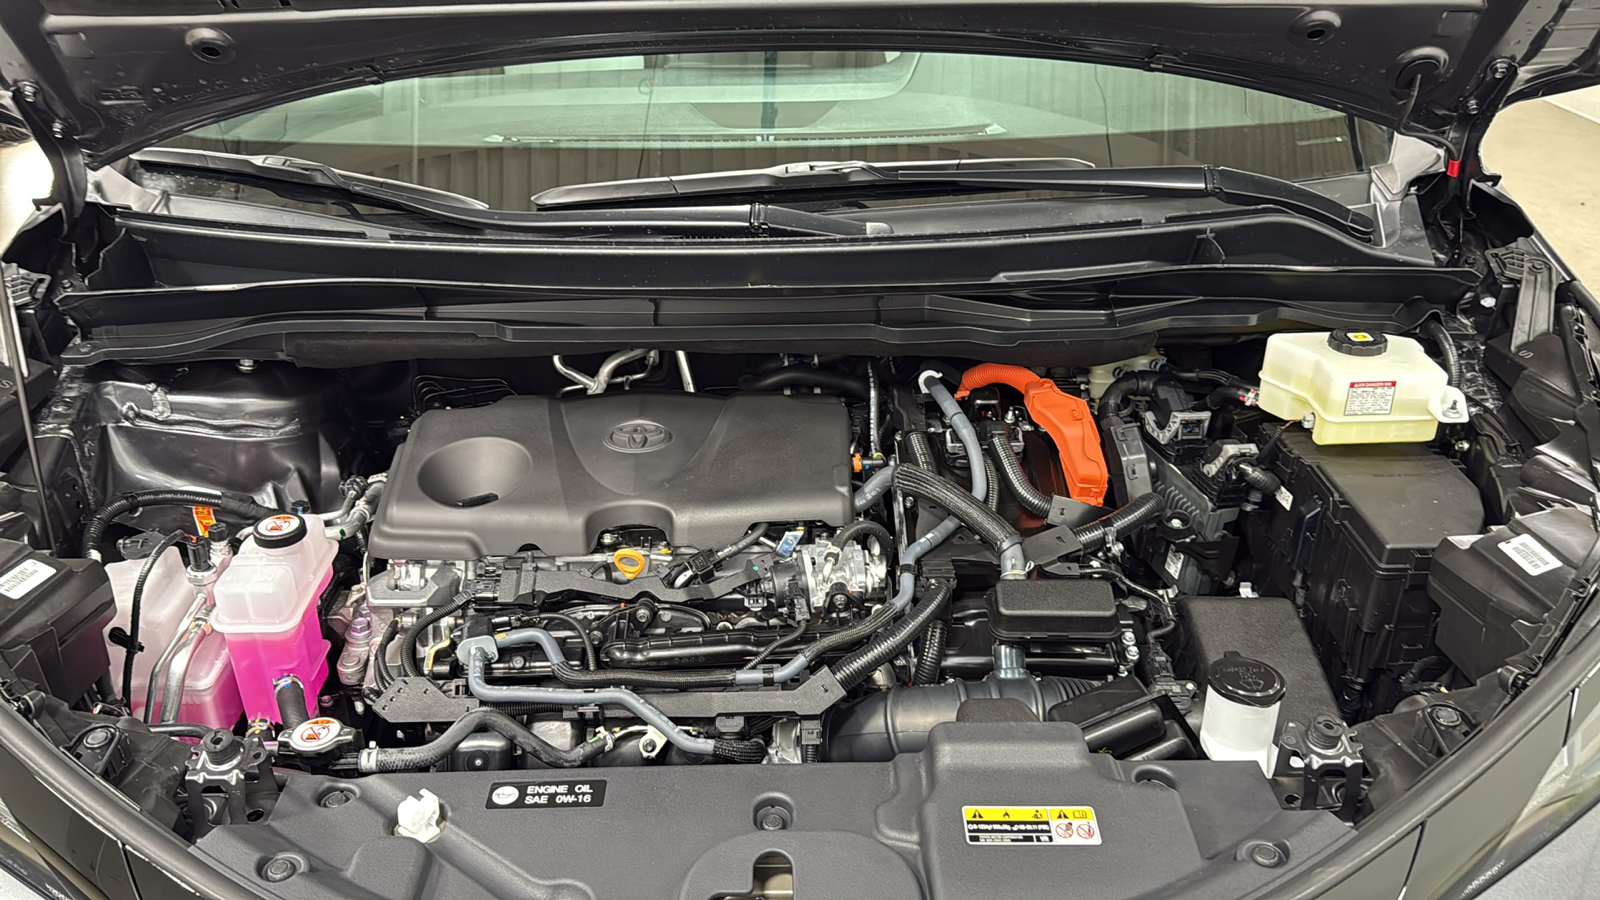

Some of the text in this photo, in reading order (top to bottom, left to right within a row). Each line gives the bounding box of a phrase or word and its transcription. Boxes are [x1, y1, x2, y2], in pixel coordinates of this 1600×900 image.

[526, 784, 593, 794] ENGINE OIL
[524, 794, 591, 804] SAE 0W-16
